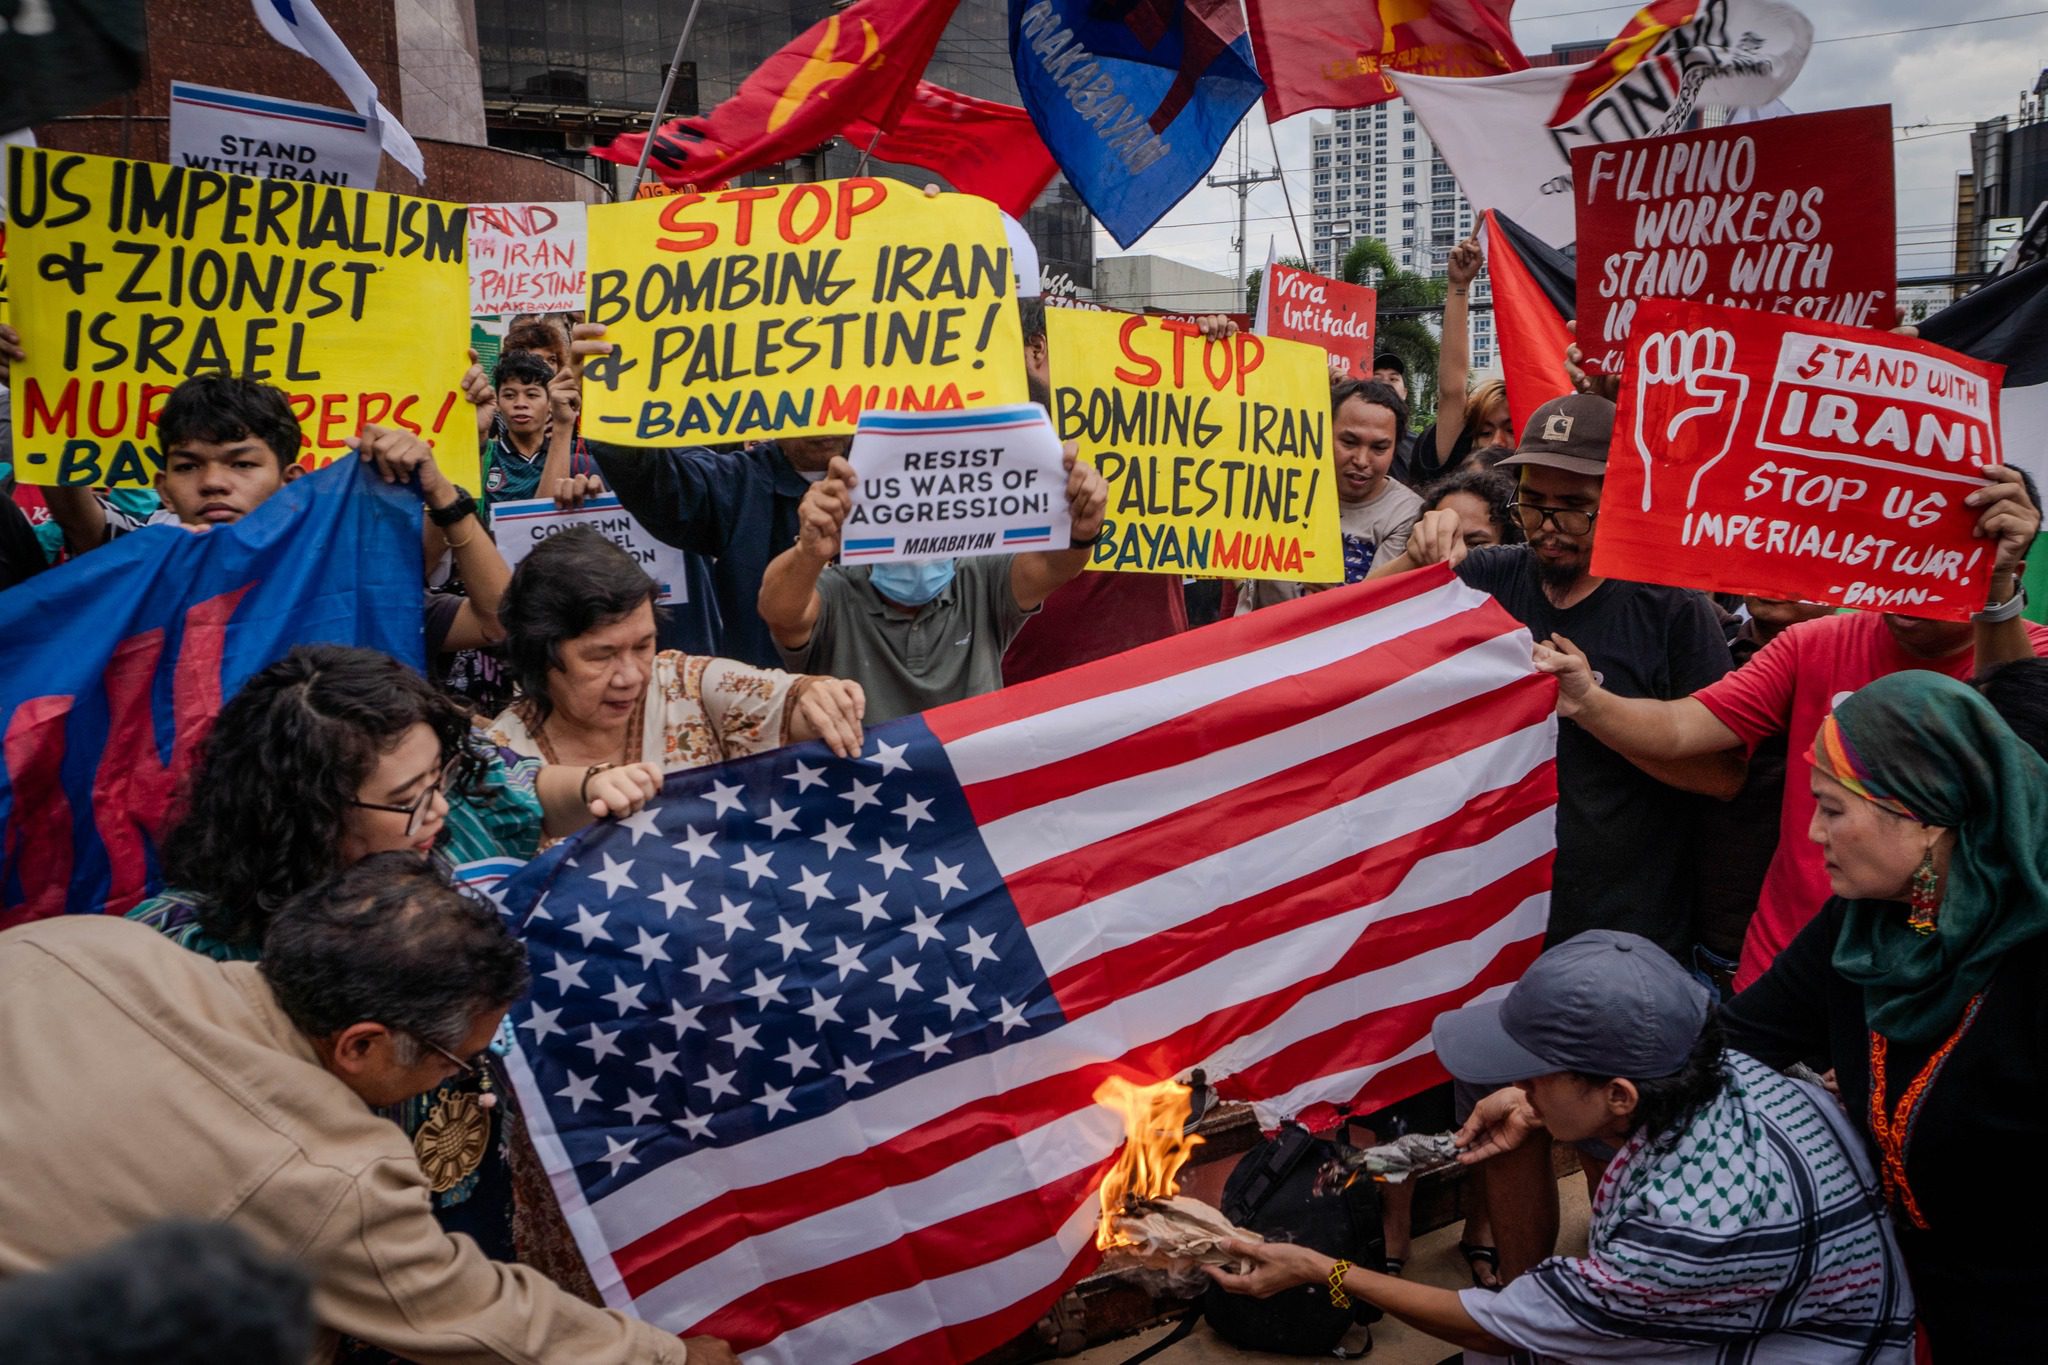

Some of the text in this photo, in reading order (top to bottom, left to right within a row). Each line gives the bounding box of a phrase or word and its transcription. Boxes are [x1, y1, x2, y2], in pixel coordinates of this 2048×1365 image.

[1021, 1, 1172, 176] MAKABAYAN
[182, 152, 349, 187] WITH IRAN!
[220, 134, 317, 164] STAND
[1588, 136, 1756, 205] FILIPINO
[8, 146, 469, 264] US IMPERIALISM
[656, 177, 888, 252] STOP
[1634, 186, 1824, 249] WORKERS
[112, 240, 374, 322] ZIONIST
[480, 269, 586, 301] PALESTINE
[503, 238, 574, 270] IRAN
[588, 243, 1009, 326] BOMBING IRAN
[1277, 271, 1327, 304] Viva
[1599, 242, 1833, 298] STAND WITH
[63, 309, 321, 381] ISRAEL
[648, 303, 1002, 392] PALESTINE!
[1115, 316, 1265, 396] STOP
[1797, 343, 1978, 406] STAND WITH
[1055, 387, 1324, 460] BOMING IRAN
[1780, 389, 1983, 467] IRAN!
[865, 469, 1038, 499] US WARS OF
[904, 448, 1004, 471] RESIST
[1095, 452, 1320, 529] PALESTINE!
[850, 493, 1048, 525] AGGRESSION!
[1744, 461, 1947, 528] STOP US
[902, 532, 996, 555] MAKABAYAN
[1681, 511, 1983, 586] IMPERIALIST WAR!
